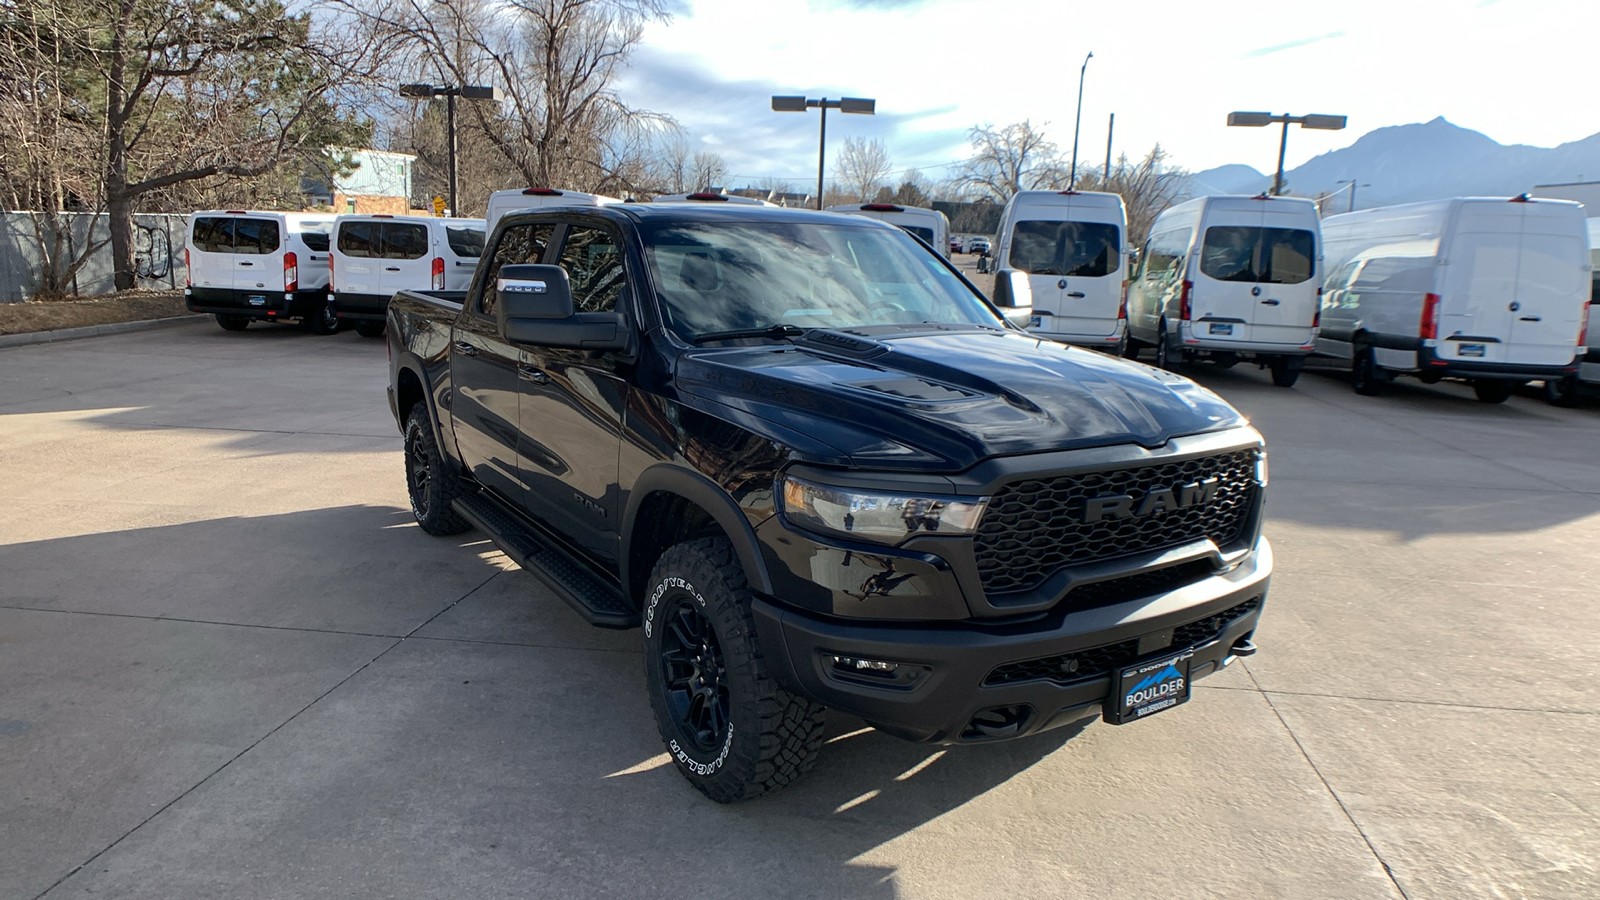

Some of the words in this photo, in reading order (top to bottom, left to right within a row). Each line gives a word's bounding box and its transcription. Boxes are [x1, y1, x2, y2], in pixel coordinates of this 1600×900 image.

[574, 492, 606, 517] RAM
[1084, 477, 1218, 523] RAM
[644, 577, 706, 639] GOODYEAR
[1126, 678, 1184, 707] BOULDER
[669, 721, 734, 776] WRANGLER
